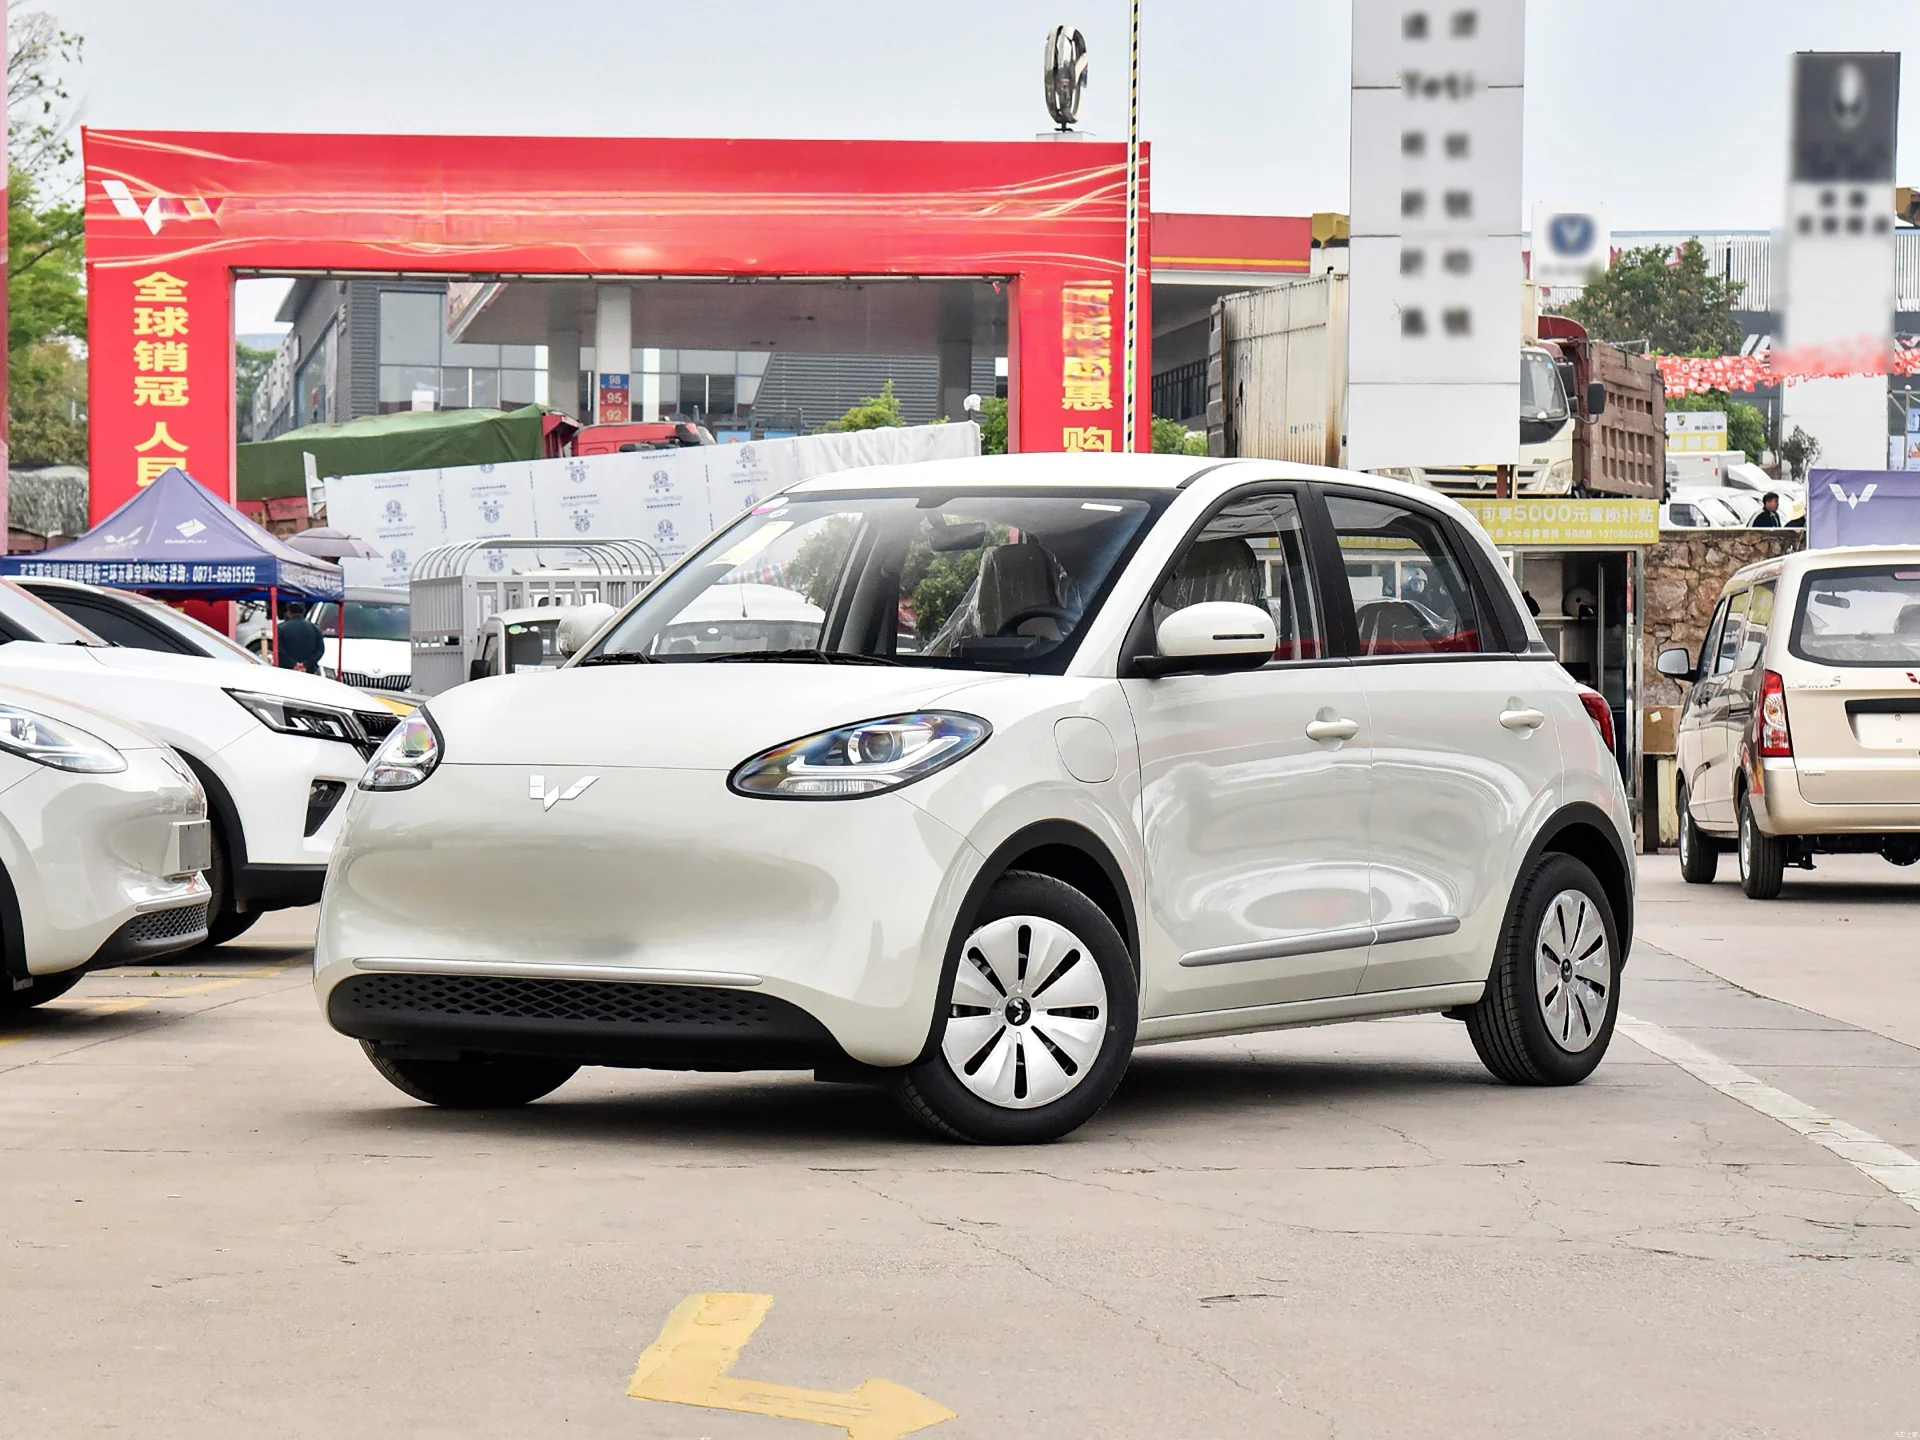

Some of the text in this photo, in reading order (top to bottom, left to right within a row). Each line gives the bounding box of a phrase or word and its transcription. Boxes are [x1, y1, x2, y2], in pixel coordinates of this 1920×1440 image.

[133, 271, 189, 406] 全球销冠
[607, 392, 622, 404] 95
[607, 410, 622, 421] 92
